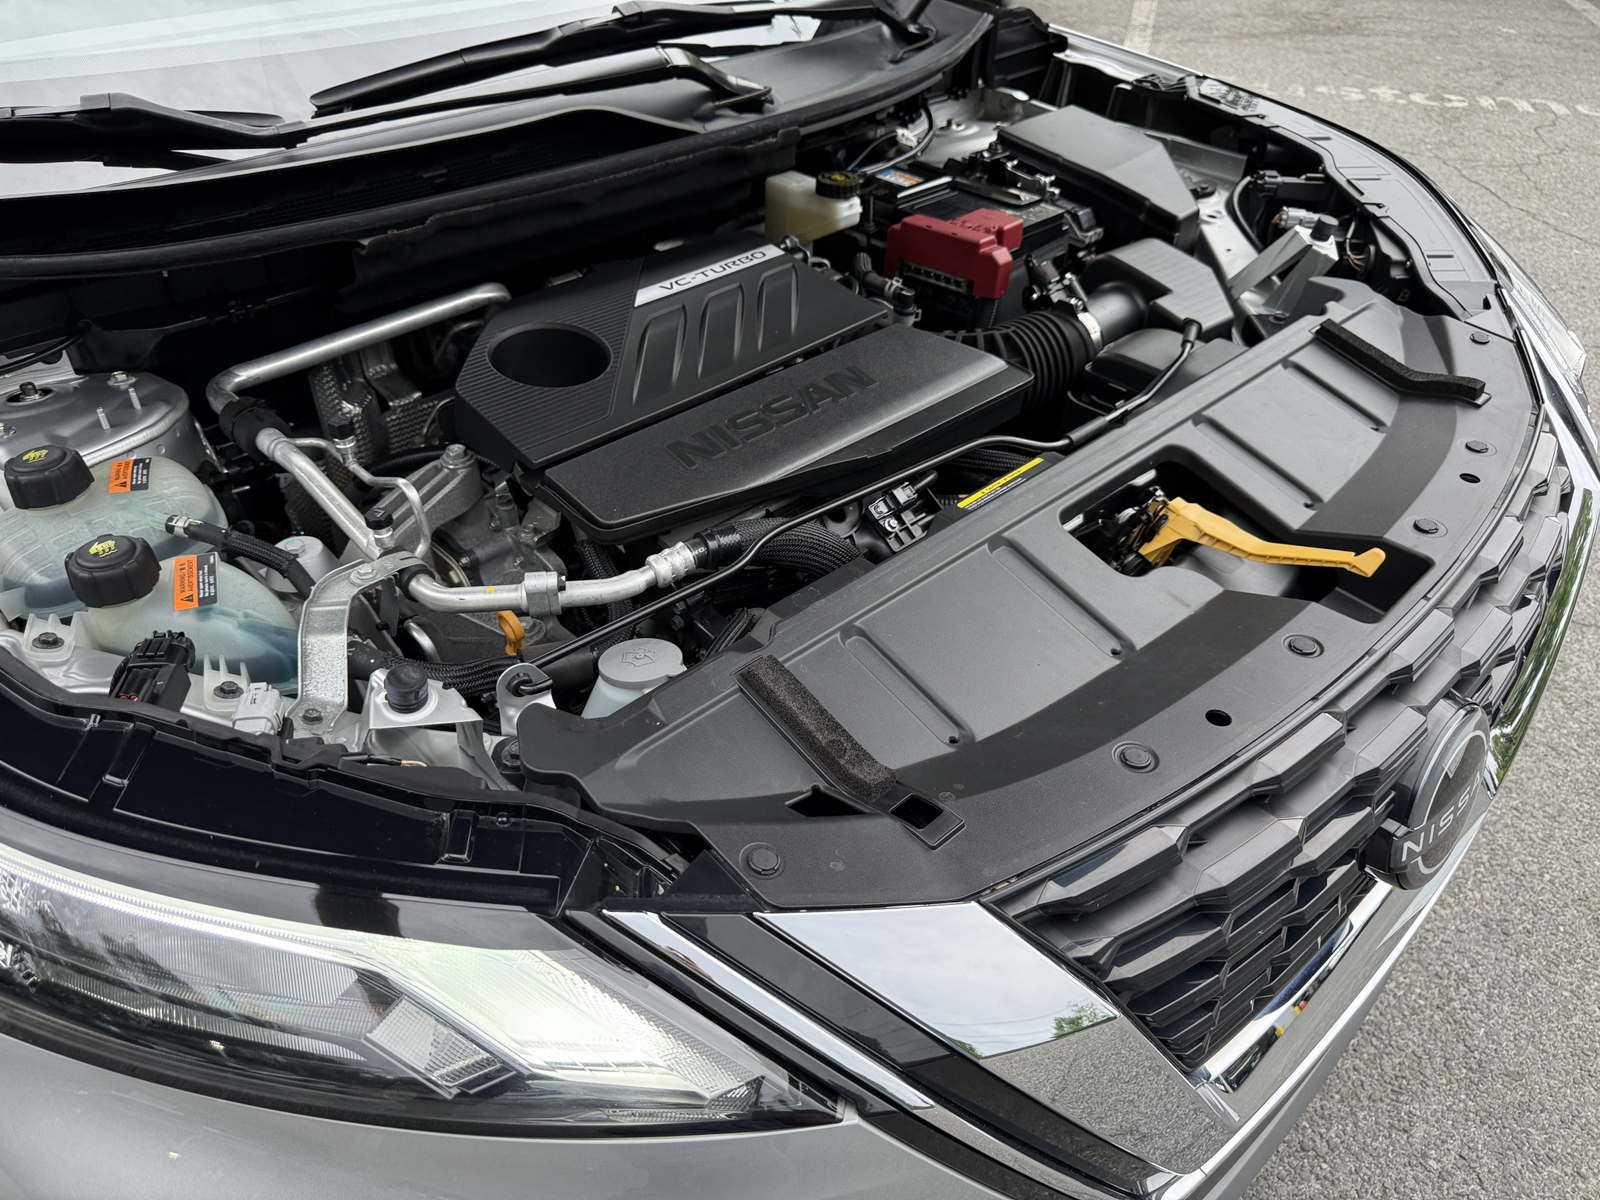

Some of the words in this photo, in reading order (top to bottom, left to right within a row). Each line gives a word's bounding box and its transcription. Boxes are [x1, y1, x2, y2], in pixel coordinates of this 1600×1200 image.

[659, 251, 767, 291] VC-TURBO
[665, 366, 879, 470] NISSAN
[1401, 770, 1480, 862] NISSA
